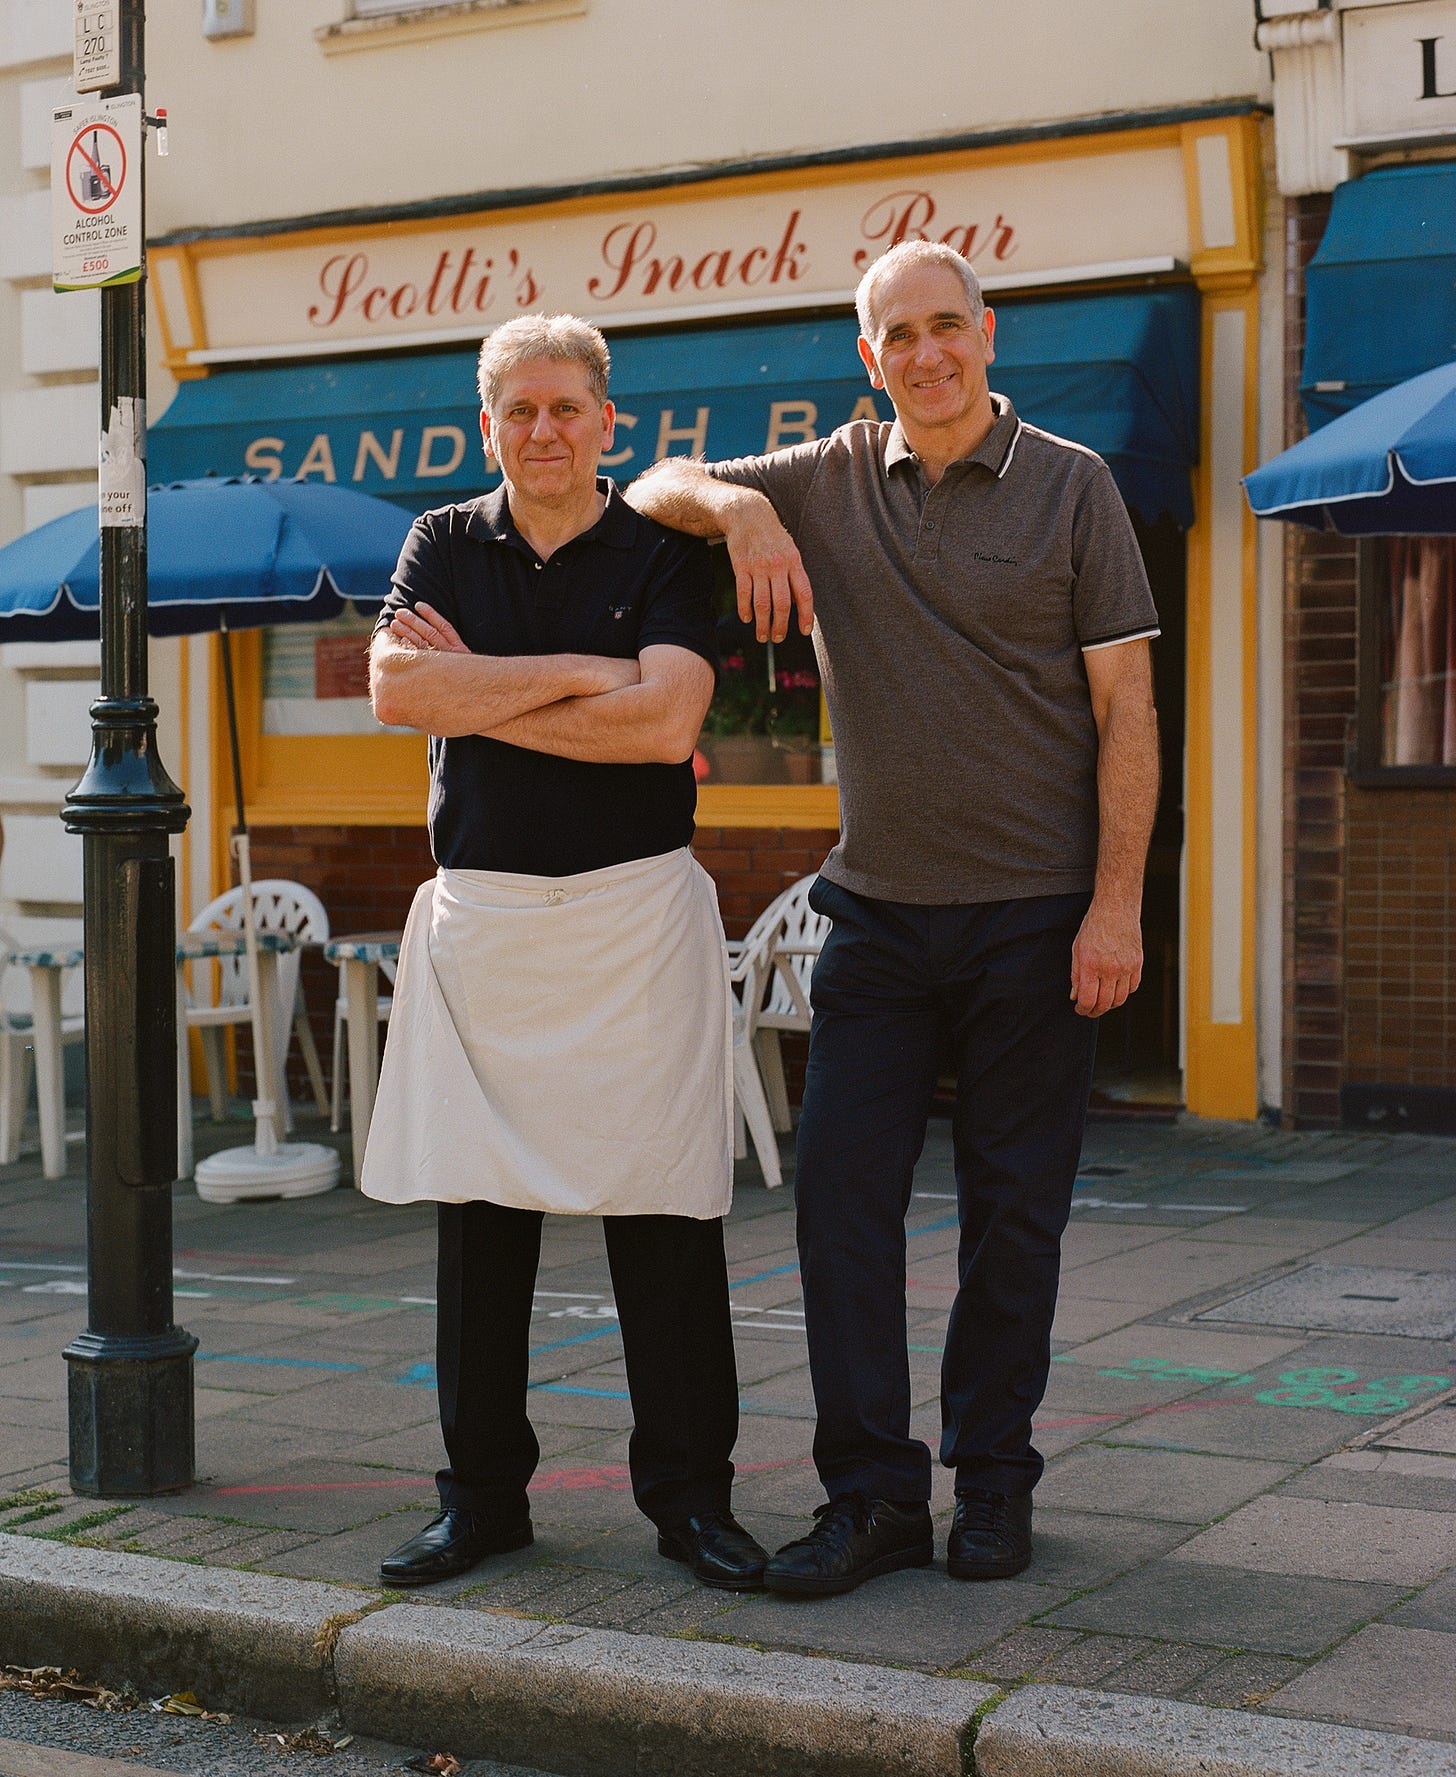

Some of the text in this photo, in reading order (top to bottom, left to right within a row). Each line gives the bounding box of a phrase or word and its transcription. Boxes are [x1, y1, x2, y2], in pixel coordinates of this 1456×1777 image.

[84, 14, 104, 33] L C
[83, 36, 105, 56] 270
[1414, 36, 1456, 101] L
[75, 214, 115, 229] ALCOHOL
[63, 225, 128, 245] CONTROL ZONE
[83, 259, 108, 272] £500
[307, 190, 1020, 327] Scotti's Snack Bar
[243, 396, 880, 482] SANDCH BA
[108, 492, 130, 503] your
[115, 504, 131, 513] off
